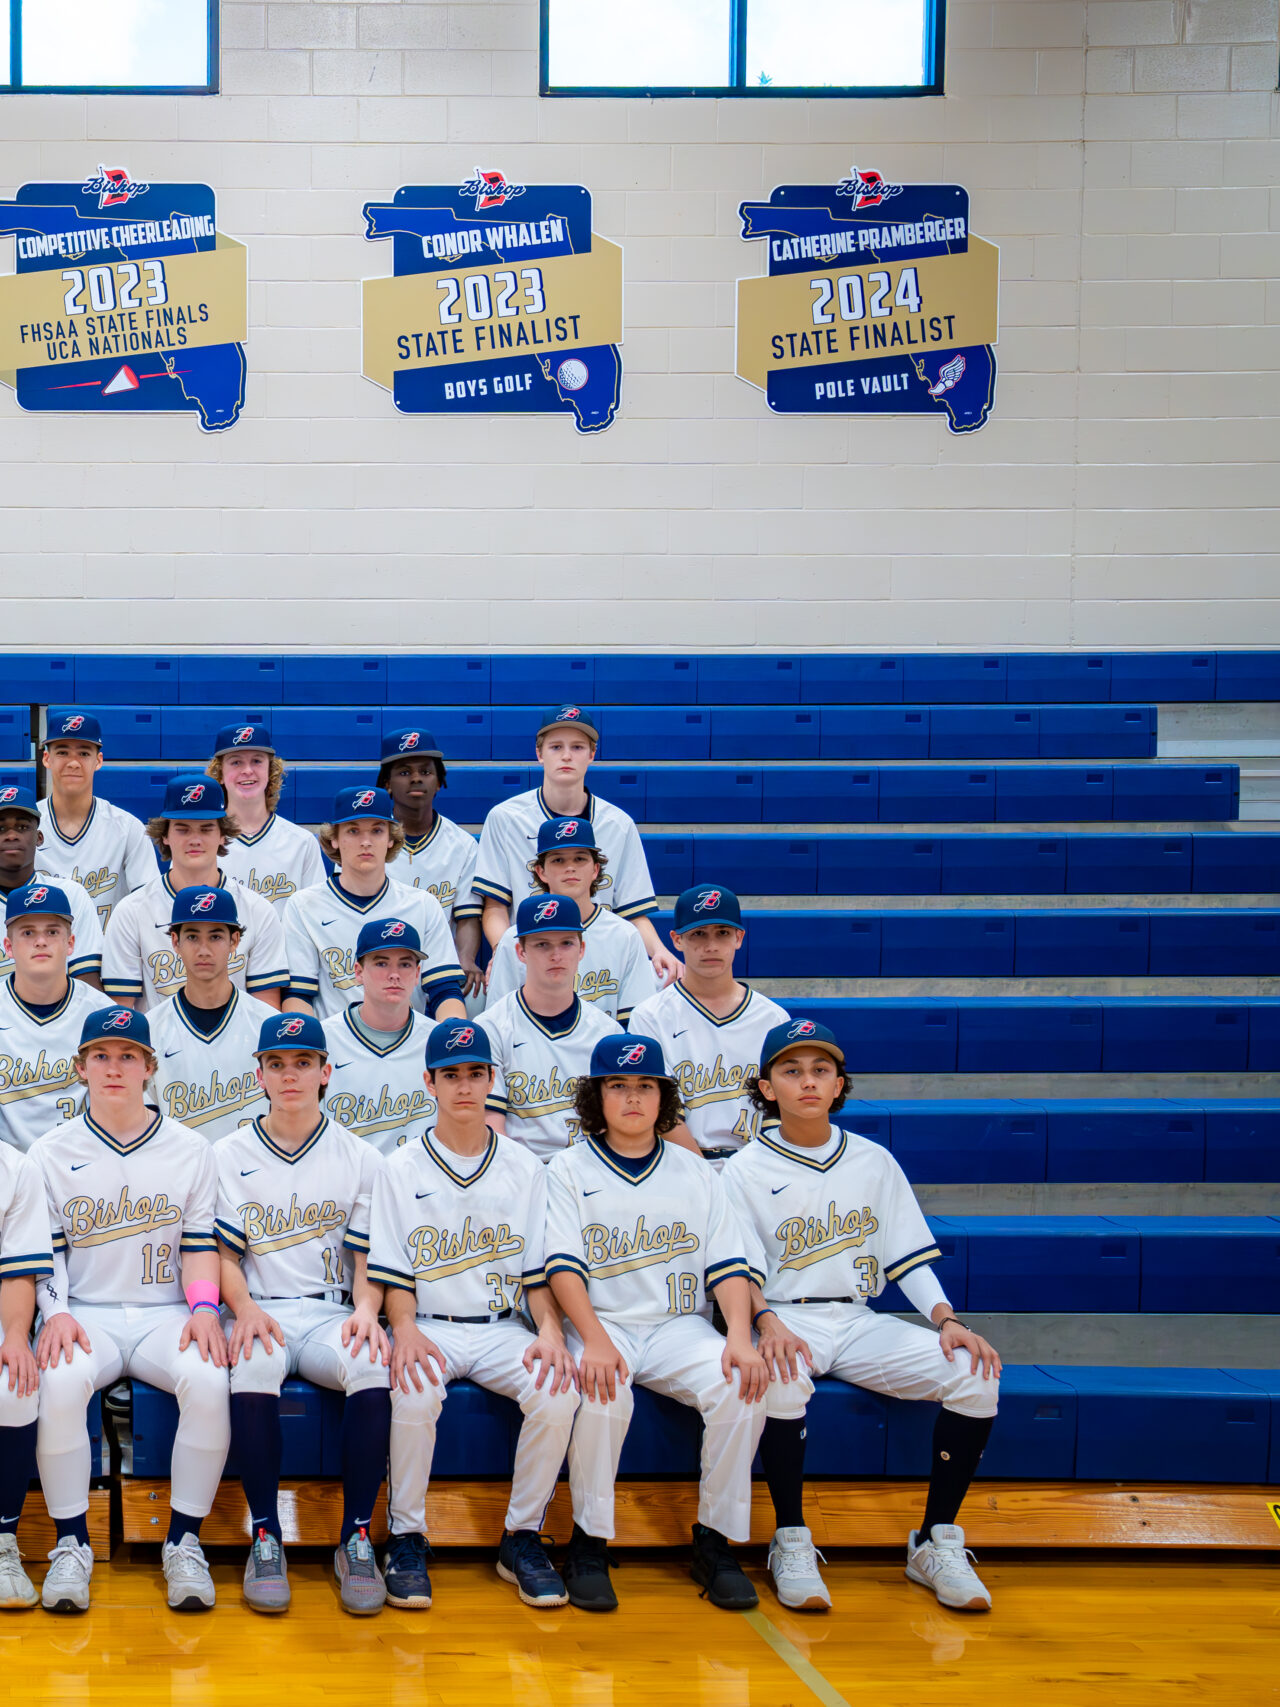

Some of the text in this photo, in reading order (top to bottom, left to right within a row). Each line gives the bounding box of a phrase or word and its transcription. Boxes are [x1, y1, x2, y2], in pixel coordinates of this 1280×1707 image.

[82, 177, 150, 197] Bishop
[460, 180, 526, 198] Bishop
[836, 179, 903, 198] Bishop
[18, 215, 215, 259] COMPETITIVE CHEERLEADING
[422, 219, 564, 259] CONOR WHALEN
[772, 217, 966, 261] CATHERINE PRAMBERGER
[62, 260, 168, 316] 2023
[436, 267, 546, 325] 2023
[810, 267, 922, 325] 2024
[20, 303, 209, 343] FHSAA STATE FINALS
[46, 327, 188, 361] UCA NATIONALS
[397, 315, 581, 360] STATE FINALIST
[771, 315, 956, 359] STATE FINALIST
[444, 373, 533, 400] BOYS GOLF
[815, 373, 909, 400] POLE VAULT
[163, 1070, 261, 1120] Bishop
[327, 1084, 437, 1128] Bishop
[505, 1066, 578, 1107] Bisho
[63, 1185, 182, 1238] Bishop
[237, 1193, 347, 1244] Bishop
[775, 1200, 878, 1262] Bishop
[408, 1216, 525, 1269] Bishop
[582, 1215, 699, 1266] Bishop
[141, 1243, 175, 1285] 12
[486, 1273, 523, 1312] 37
[666, 1272, 699, 1314] 18
